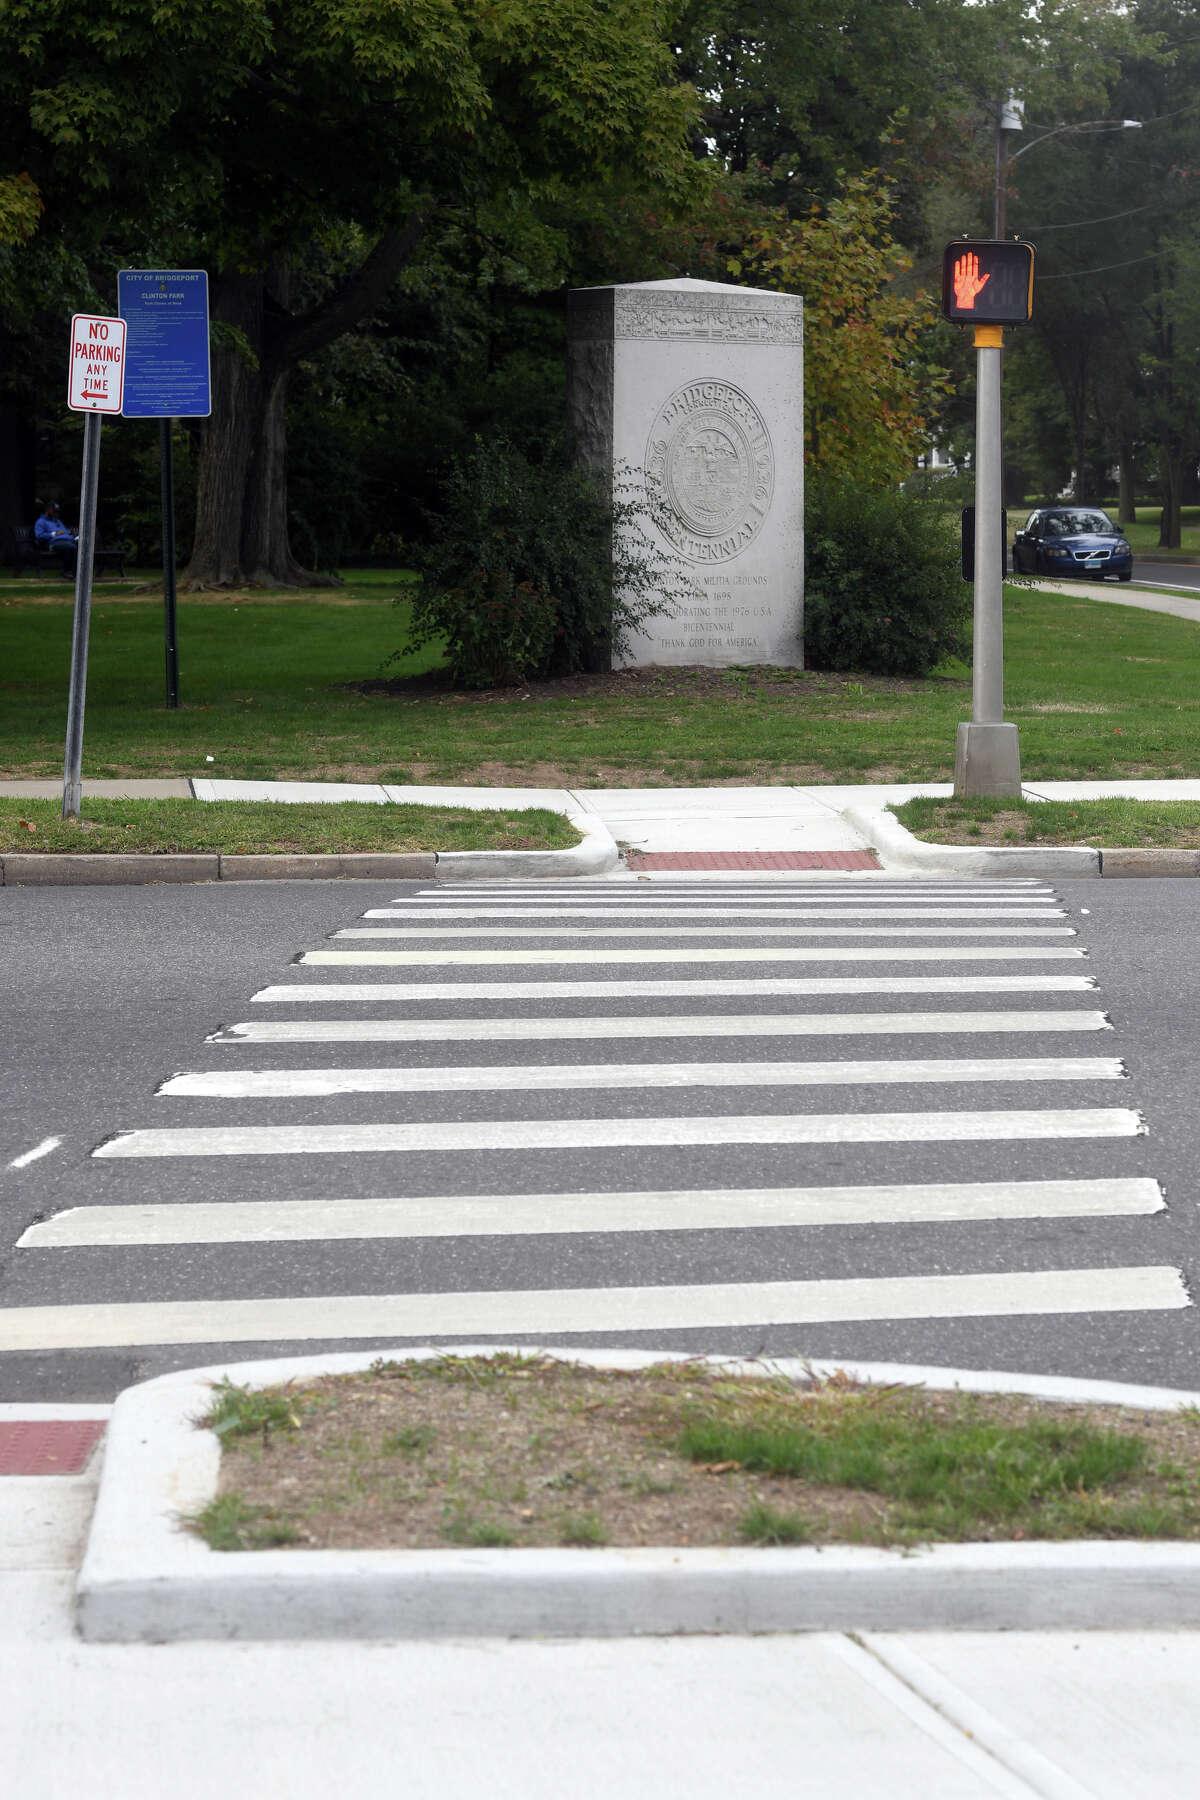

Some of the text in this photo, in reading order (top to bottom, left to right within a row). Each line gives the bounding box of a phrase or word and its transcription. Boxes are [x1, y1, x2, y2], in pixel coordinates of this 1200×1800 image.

[88, 322, 109, 341] NO
[74, 342, 121, 363] PARKING
[86, 364, 108, 376] ANY
[83, 378, 109, 391] TIME
[662, 385, 759, 430] BRIDGEPORT
[704, 576, 730, 585] MILITIA
[733, 576, 768, 585] GROUNDS
[714, 605, 729, 616] THE
[683, 622, 735, 632] BICENTENNIAL
[689, 638, 705, 648] GOD
[708, 638, 722, 648] FOR
